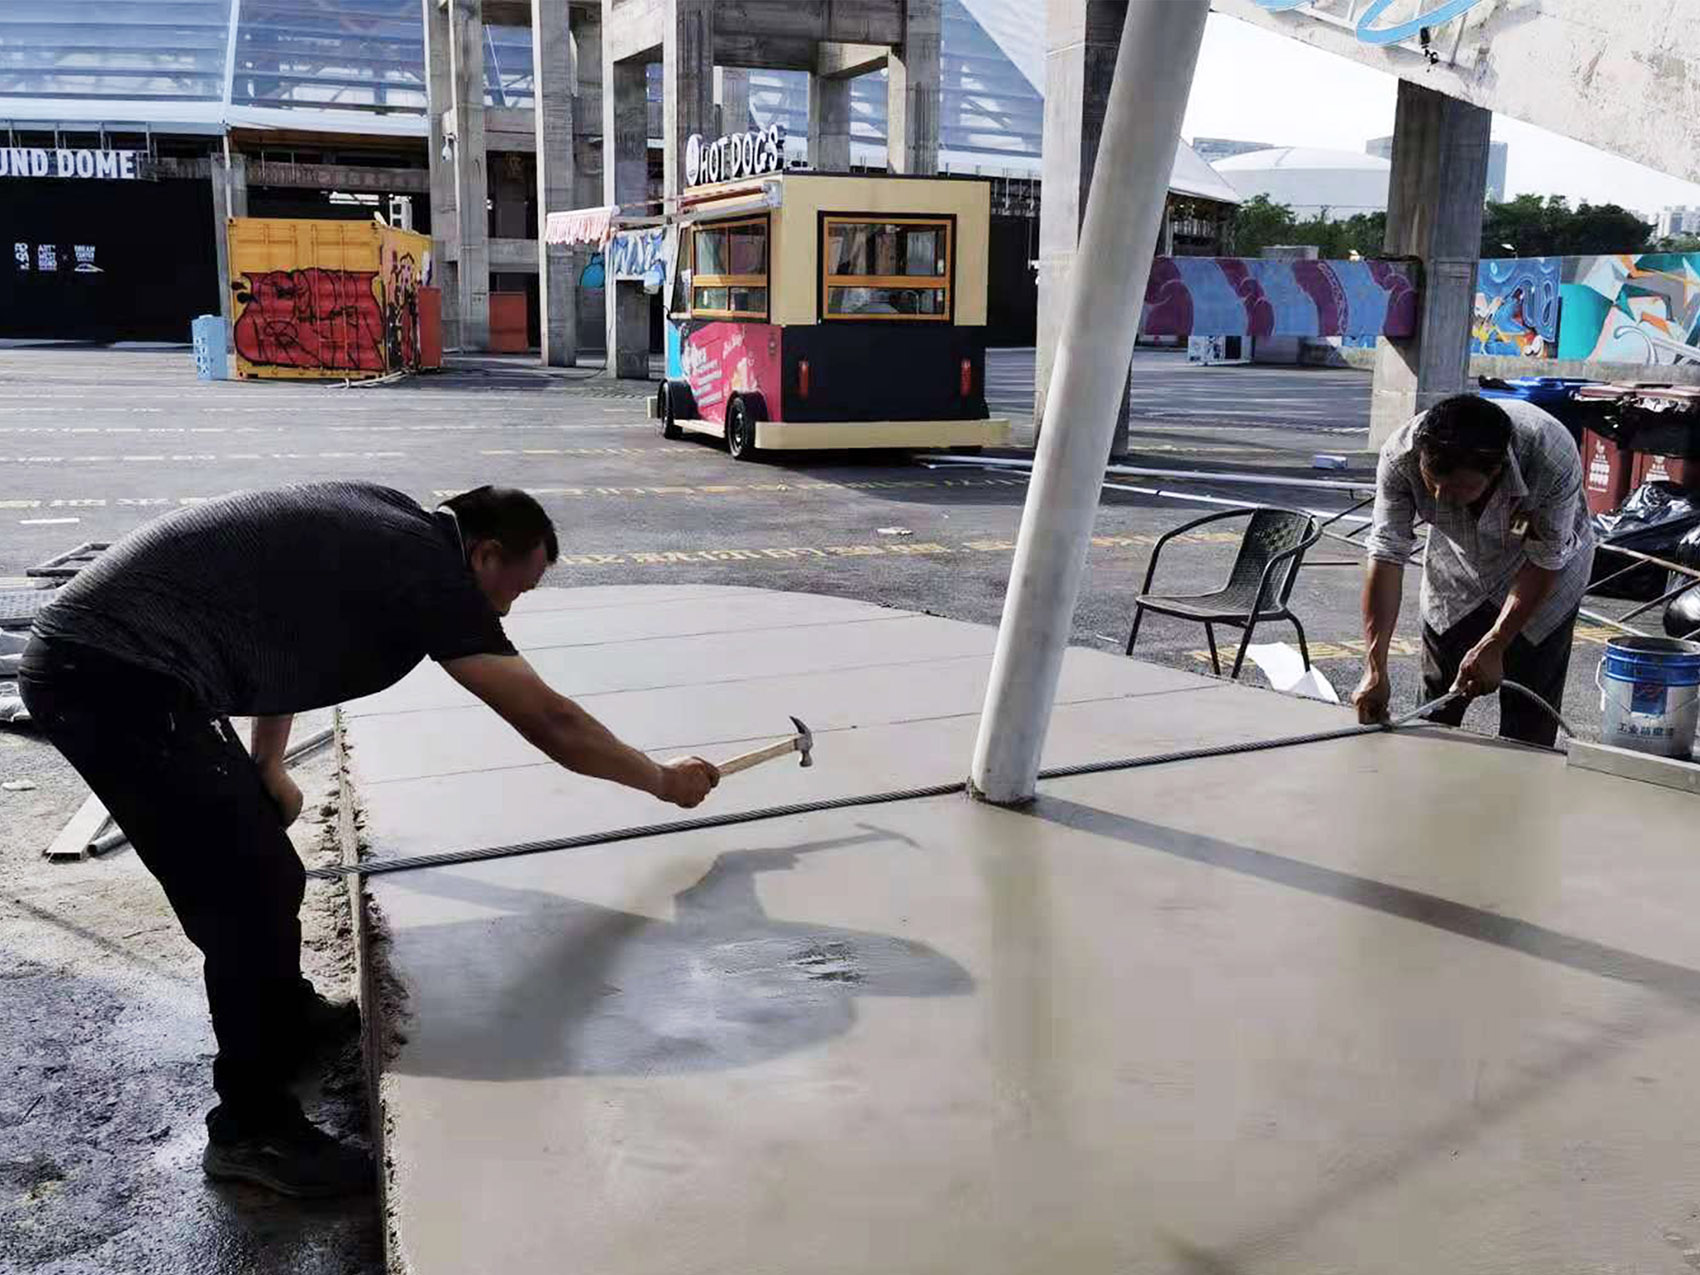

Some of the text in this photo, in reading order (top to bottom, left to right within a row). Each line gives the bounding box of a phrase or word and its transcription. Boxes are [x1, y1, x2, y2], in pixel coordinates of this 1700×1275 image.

[56, 149, 135, 179] DOME
[700, 123, 778, 184] HOT DOGS
